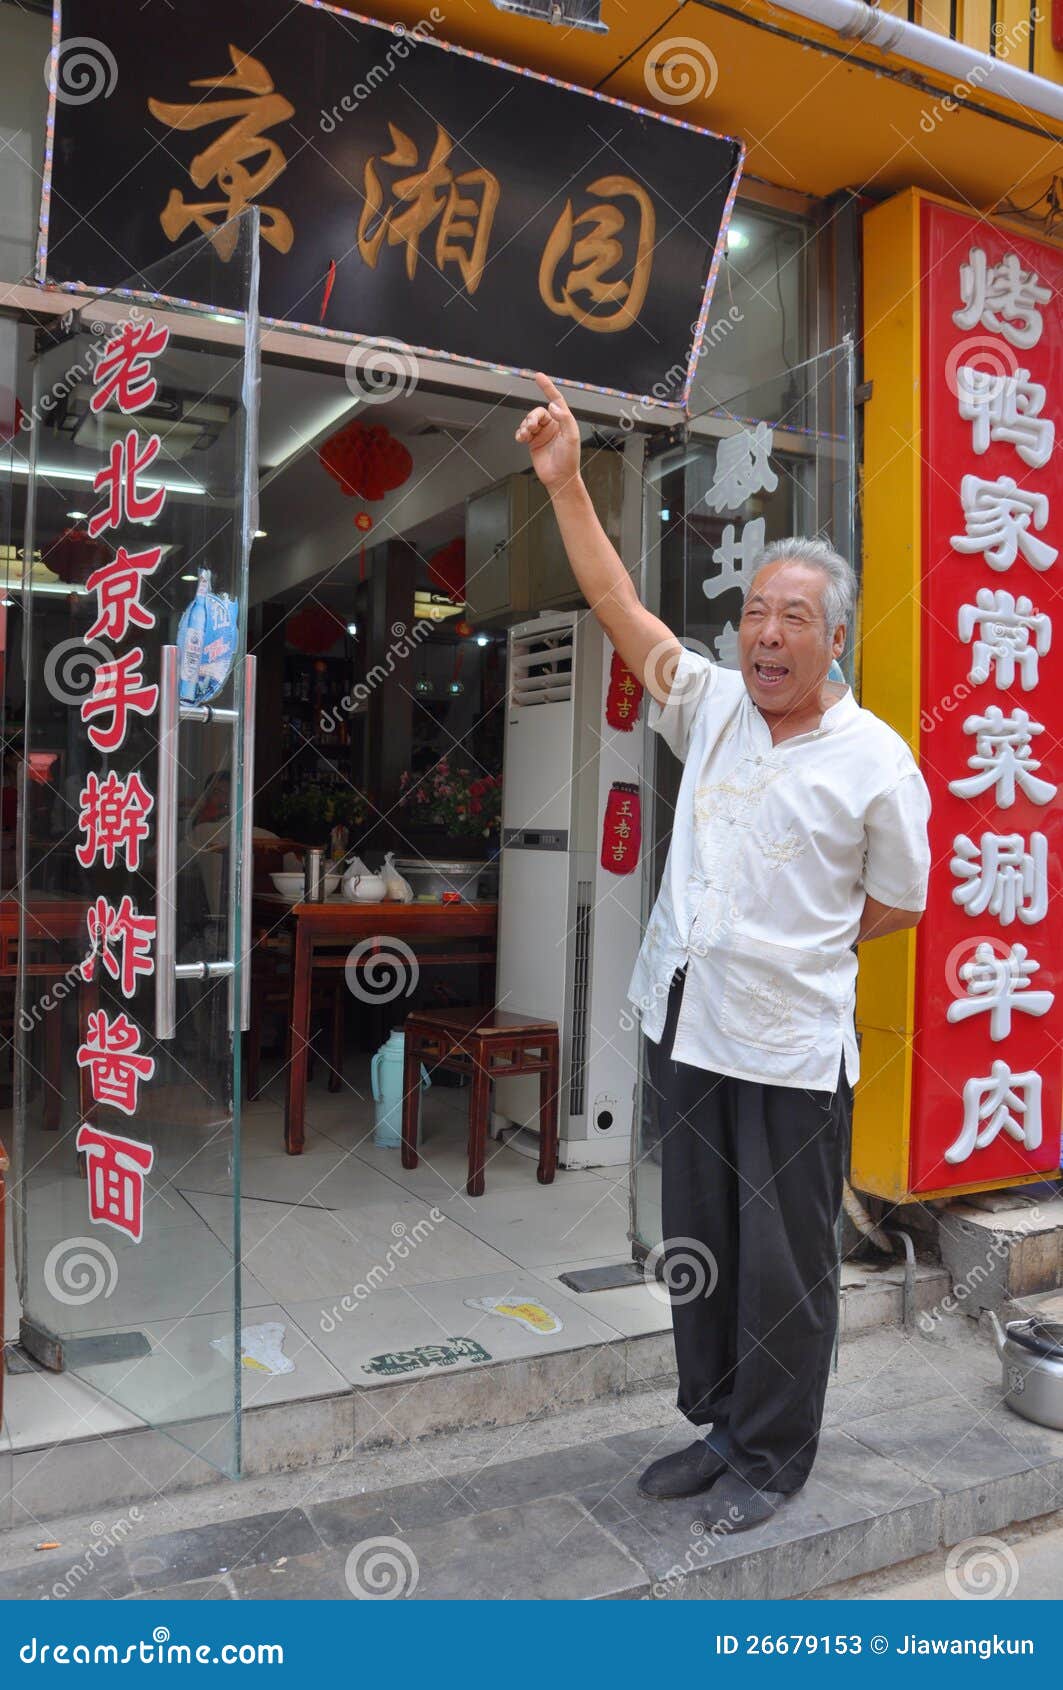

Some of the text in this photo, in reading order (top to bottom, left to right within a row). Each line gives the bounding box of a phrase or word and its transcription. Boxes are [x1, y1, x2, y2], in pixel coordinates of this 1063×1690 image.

[75, 318, 170, 1243] 老北京手擀炸酱面
[611, 800, 633, 861] 王老吉
[945, 246, 1058, 1164] 烤鸭家常菜涮羊肉
